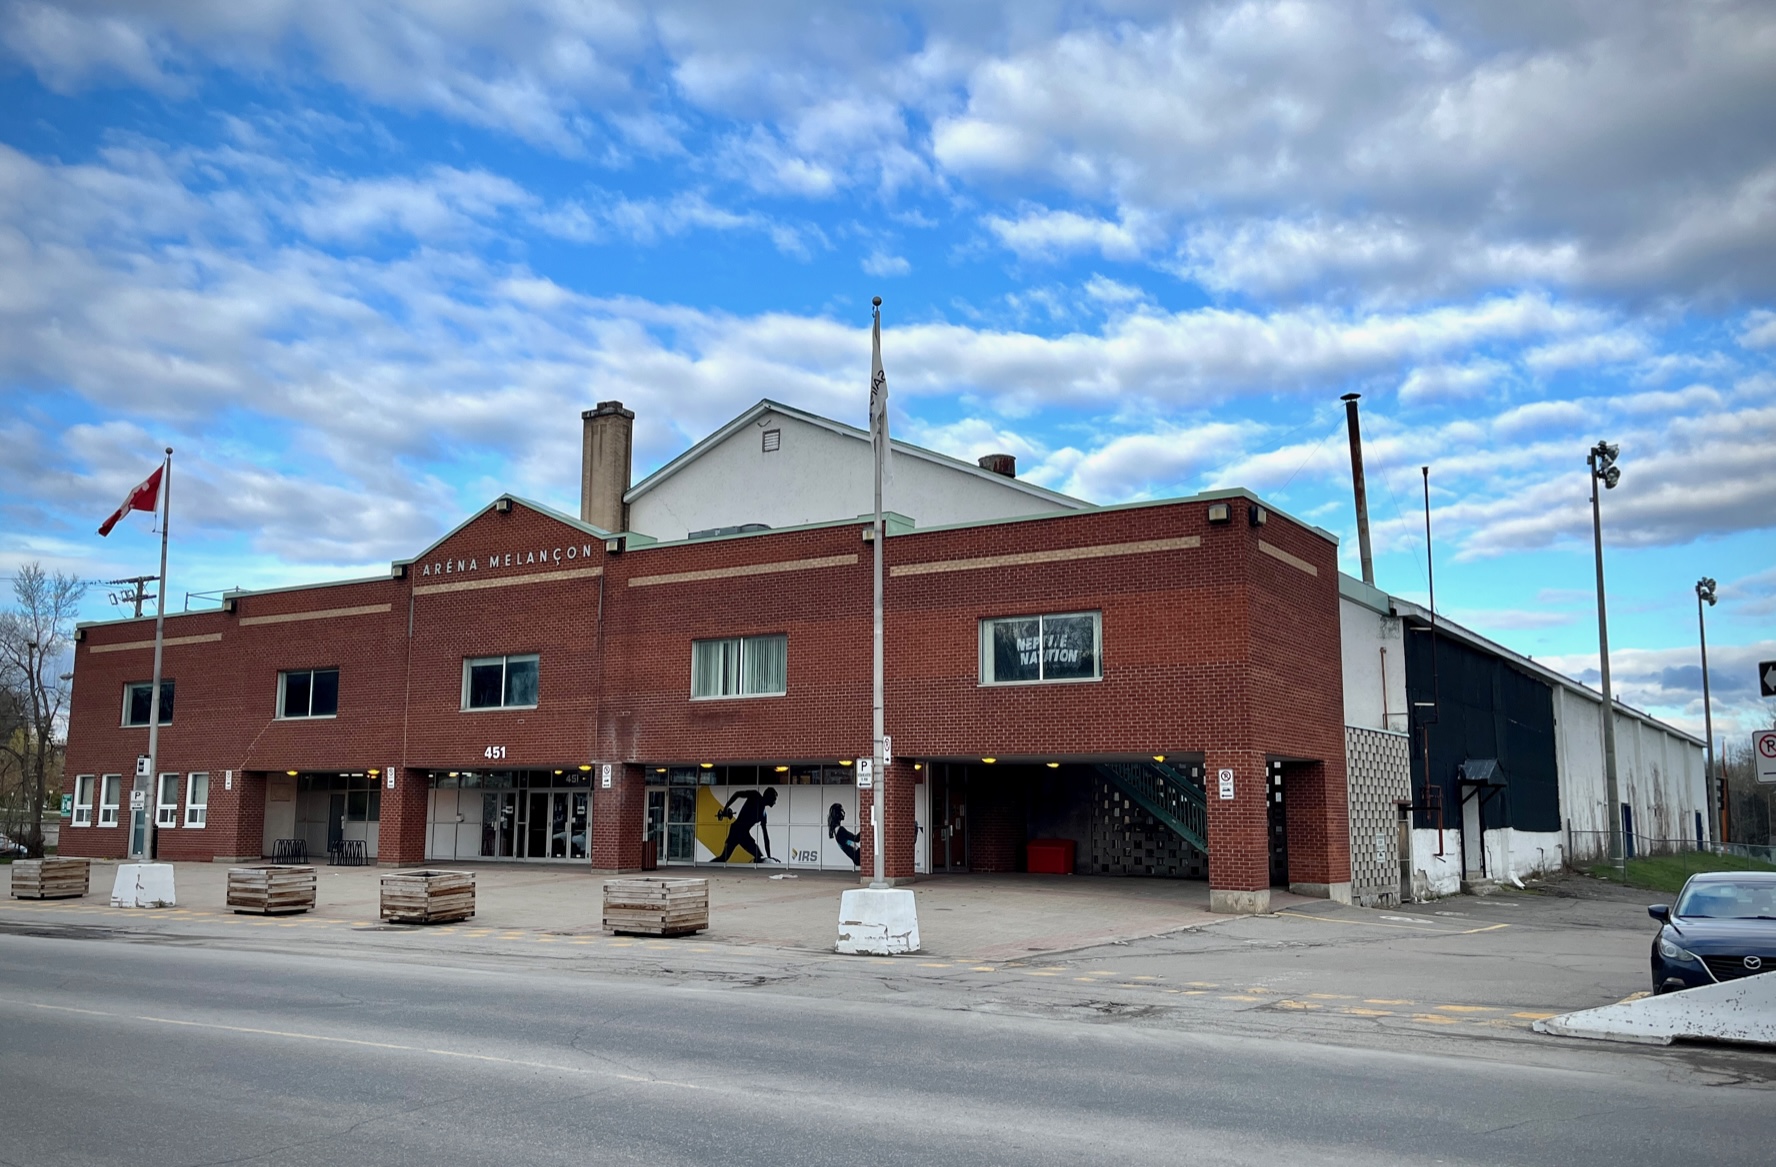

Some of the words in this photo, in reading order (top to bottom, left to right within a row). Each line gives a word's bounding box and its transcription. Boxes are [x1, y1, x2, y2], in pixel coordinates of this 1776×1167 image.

[422, 558, 477, 576] ARÉNA
[489, 544, 591, 568] MELANÇON
[484, 746, 506, 759] 451
[861, 760, 868, 772] P
[565, 774, 579, 783] 451
[134, 791, 141, 800] P
[798, 850, 818, 862] IRS
